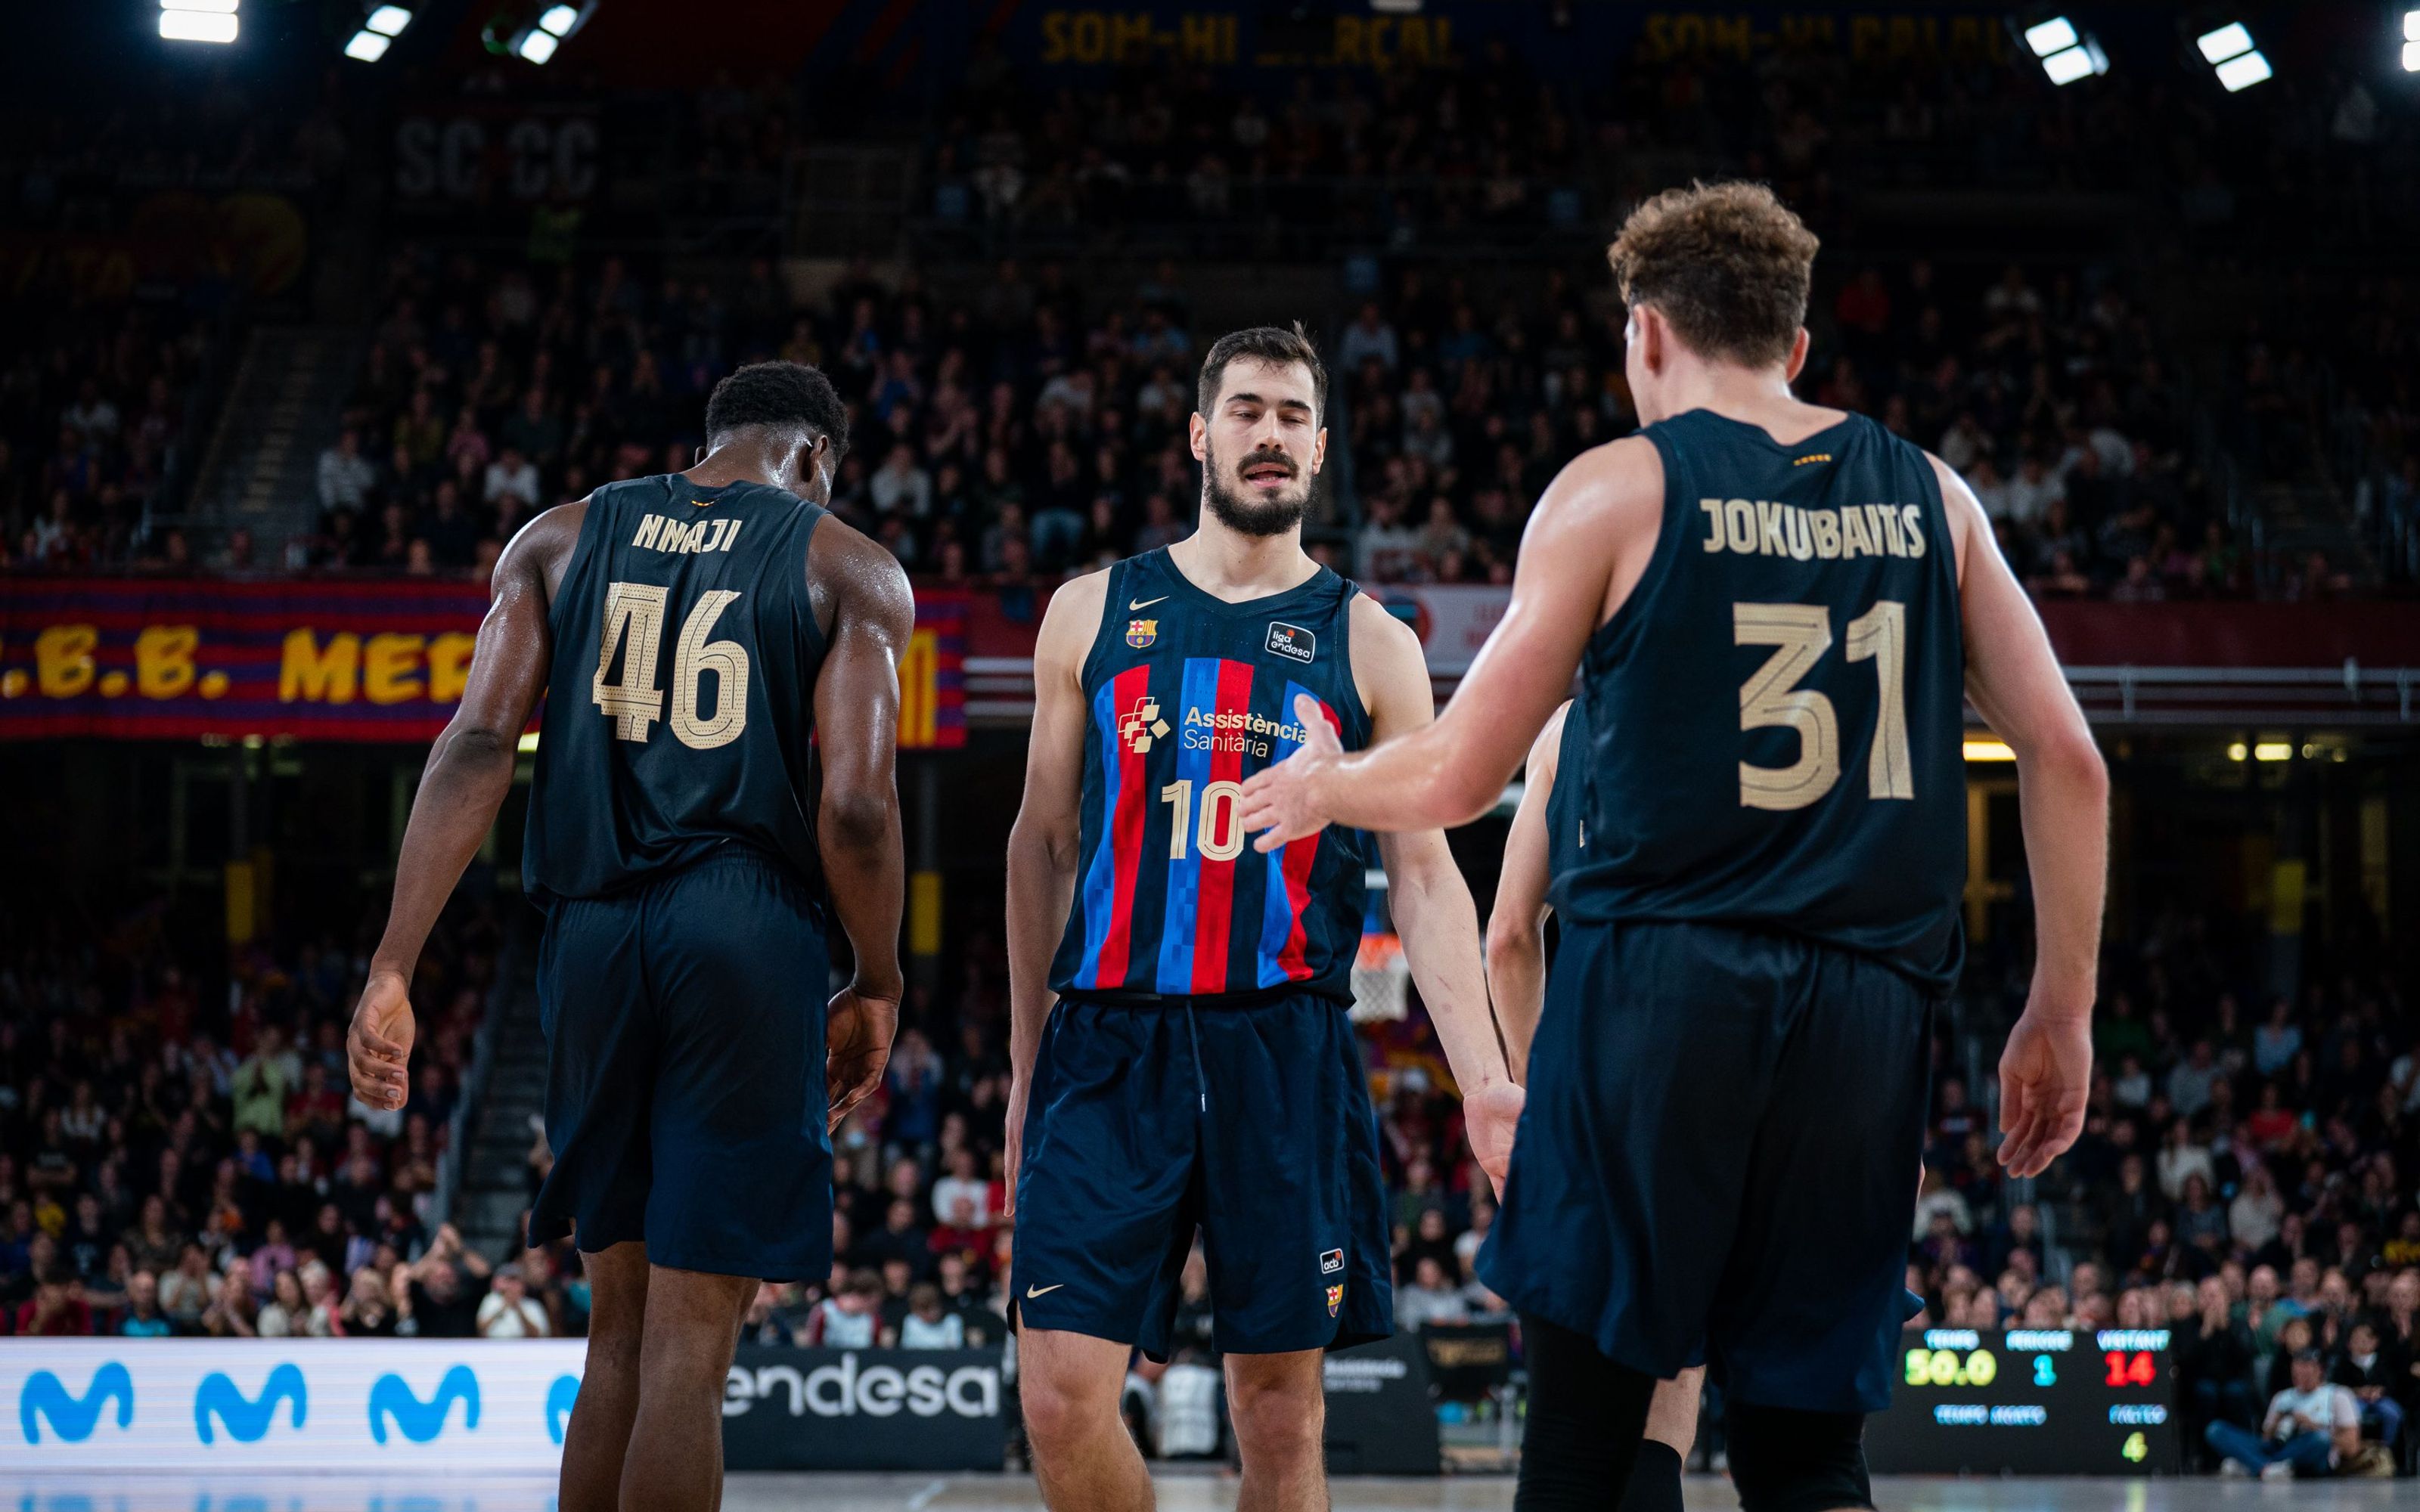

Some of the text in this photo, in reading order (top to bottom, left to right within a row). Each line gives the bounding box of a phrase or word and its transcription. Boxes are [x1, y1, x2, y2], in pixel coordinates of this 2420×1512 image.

[1041, 11, 1240, 67] SOM-HI
[632, 513, 743, 554] NNAJI
[1270, 640, 1311, 658] endesa
[1273, 631, 1292, 643] liga
[0, 624, 229, 700] .B.B.
[592, 581, 750, 750] 46
[1732, 600, 1916, 811] 31
[1184, 706, 1308, 744] Assistència
[1184, 729, 1269, 758] Sanitària
[1161, 779, 1245, 861] 10
[1323, 1257, 1339, 1271] acb
[721, 1351, 1000, 1417] endesa
[1905, 1349, 1996, 1387] 50.0
[2105, 1349, 2156, 1387] 14
[2121, 1431, 2148, 1463] 4
